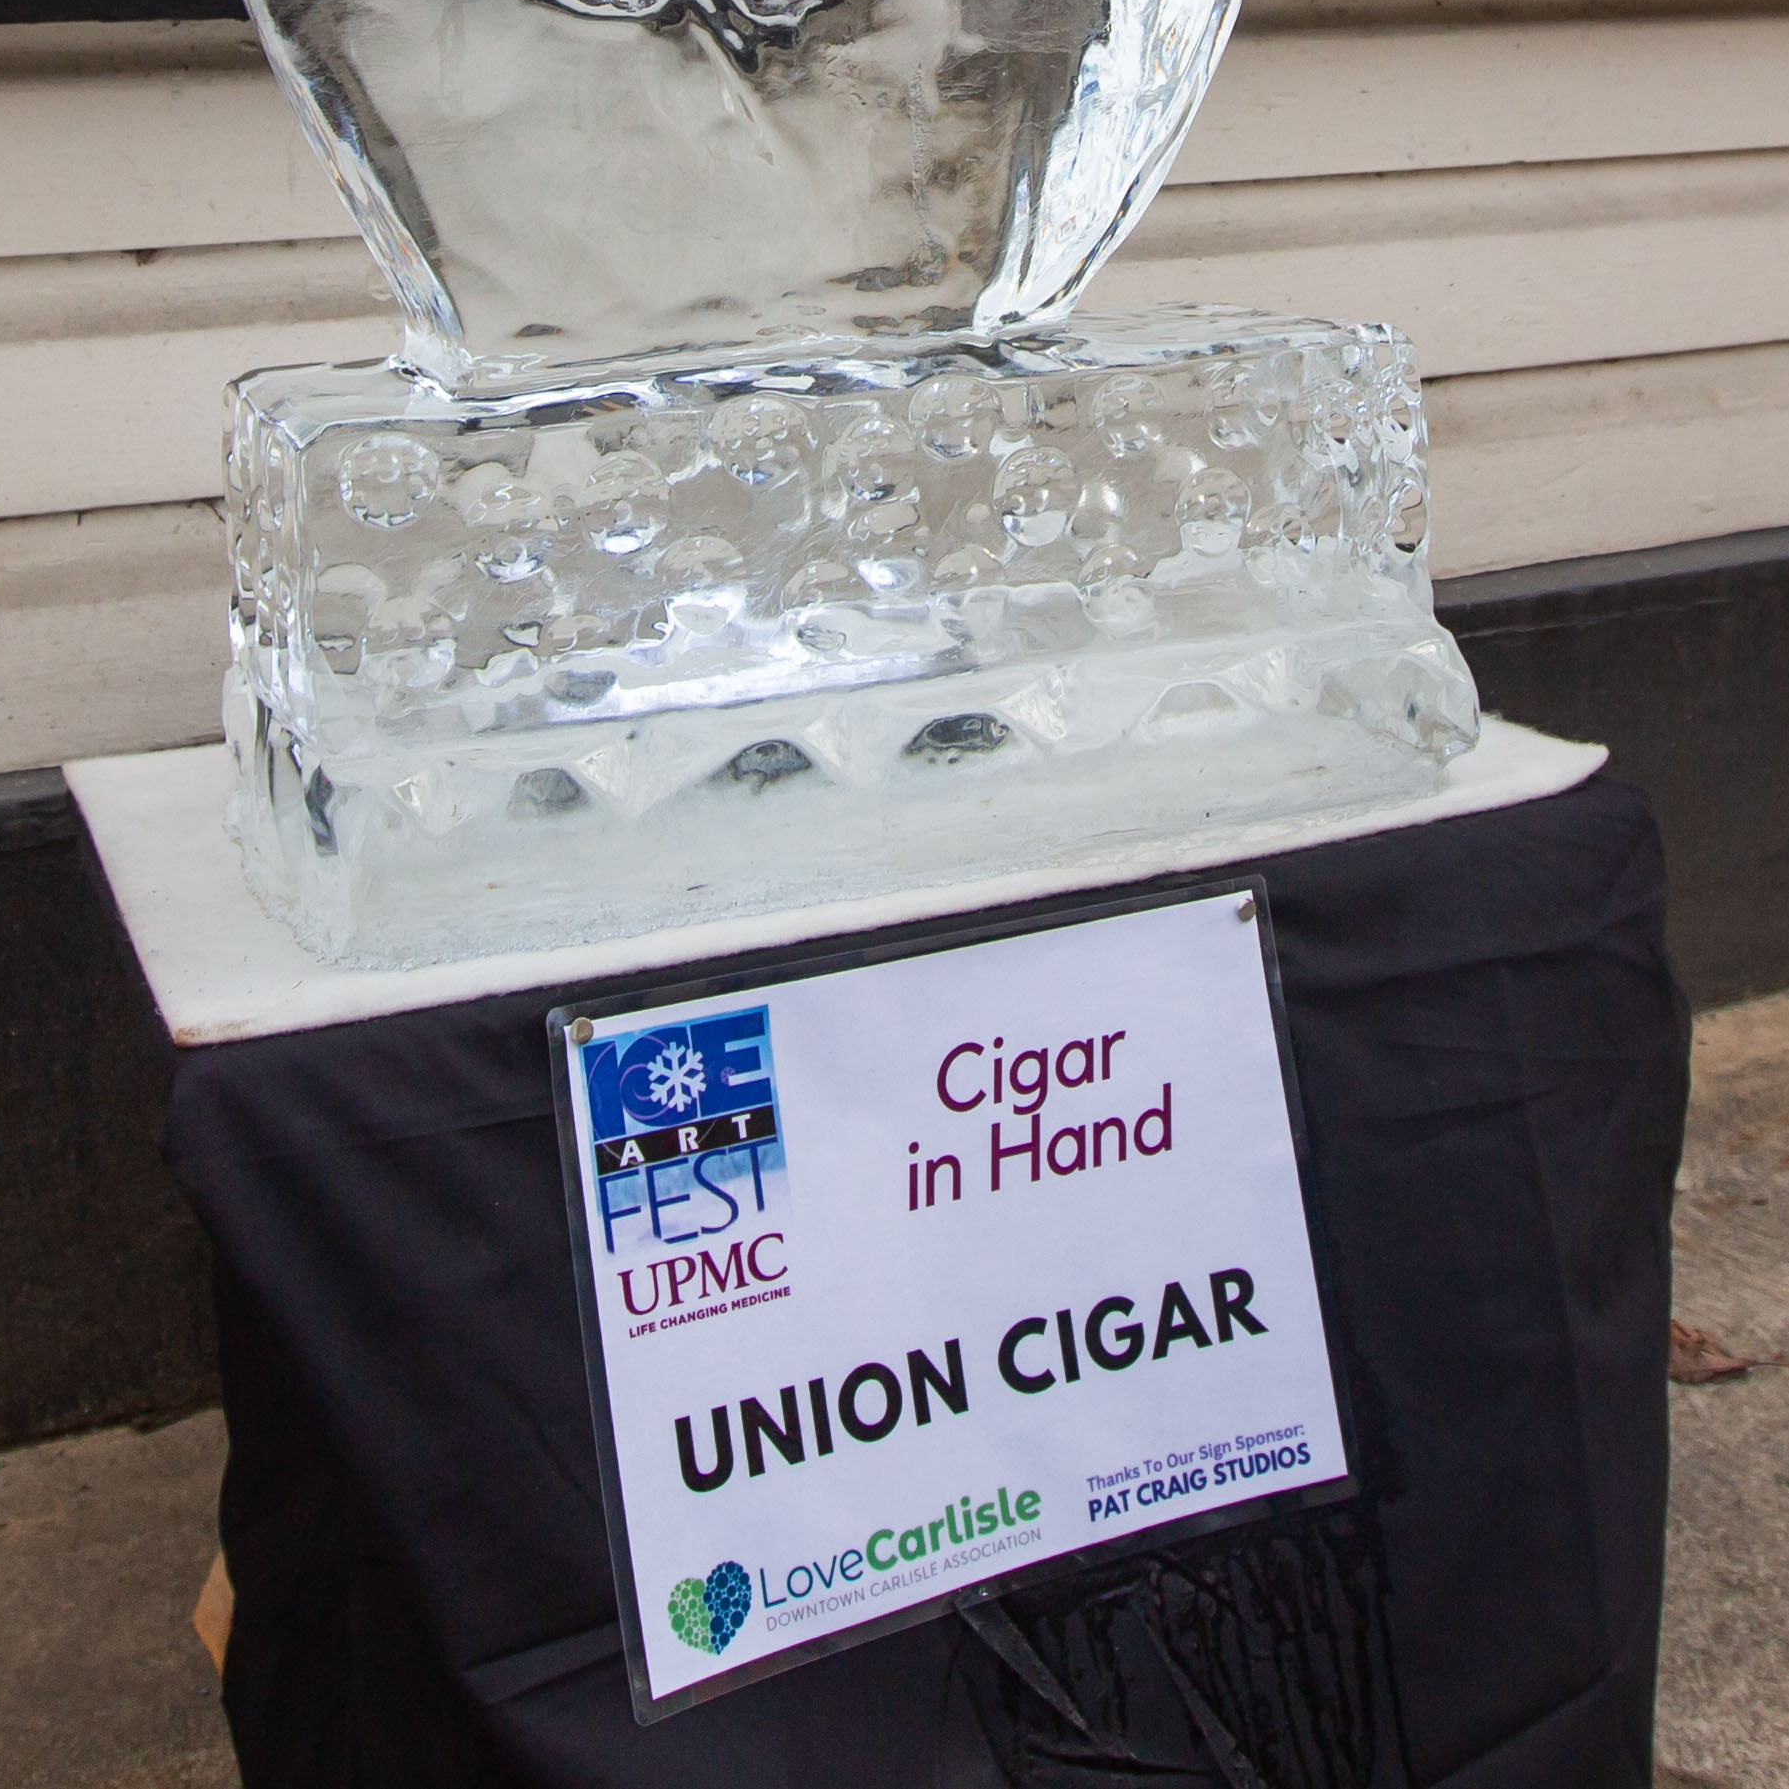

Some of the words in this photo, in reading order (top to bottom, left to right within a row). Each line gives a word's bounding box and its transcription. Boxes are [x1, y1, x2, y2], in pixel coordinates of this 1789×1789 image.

[583, 1011, 773, 1134] ICE
[936, 1030, 1126, 1116] Cigar
[619, 1113, 752, 1168] ART
[908, 1141, 962, 1212] in
[990, 1082, 1172, 1193] Hand
[598, 1135, 779, 1254] FEST
[617, 1232, 789, 1316] UPMC
[628, 1321, 657, 1339] LIFE
[660, 1303, 728, 1329] CHANGING
[730, 1285, 792, 1311] MEDICINE
[674, 1337, 969, 1494] UNION
[997, 1267, 1269, 1395] CIGAR
[1086, 1465, 1141, 1493] Thanks
[1143, 1459, 1164, 1476] To
[1166, 1450, 1197, 1469] Our
[1198, 1439, 1233, 1462] Sign
[1234, 1422, 1307, 1452] Sponsor:
[1087, 1489, 1132, 1523] PAT
[1135, 1468, 1208, 1507] CRAIG
[1212, 1442, 1312, 1486] STUDIOS
[759, 1487, 1042, 1609] LoveCarlisle
[765, 1586, 867, 1633] DOWNTOWN
[869, 1561, 939, 1599] CARLISLE
[942, 1526, 1043, 1572] ASSOCIATION
